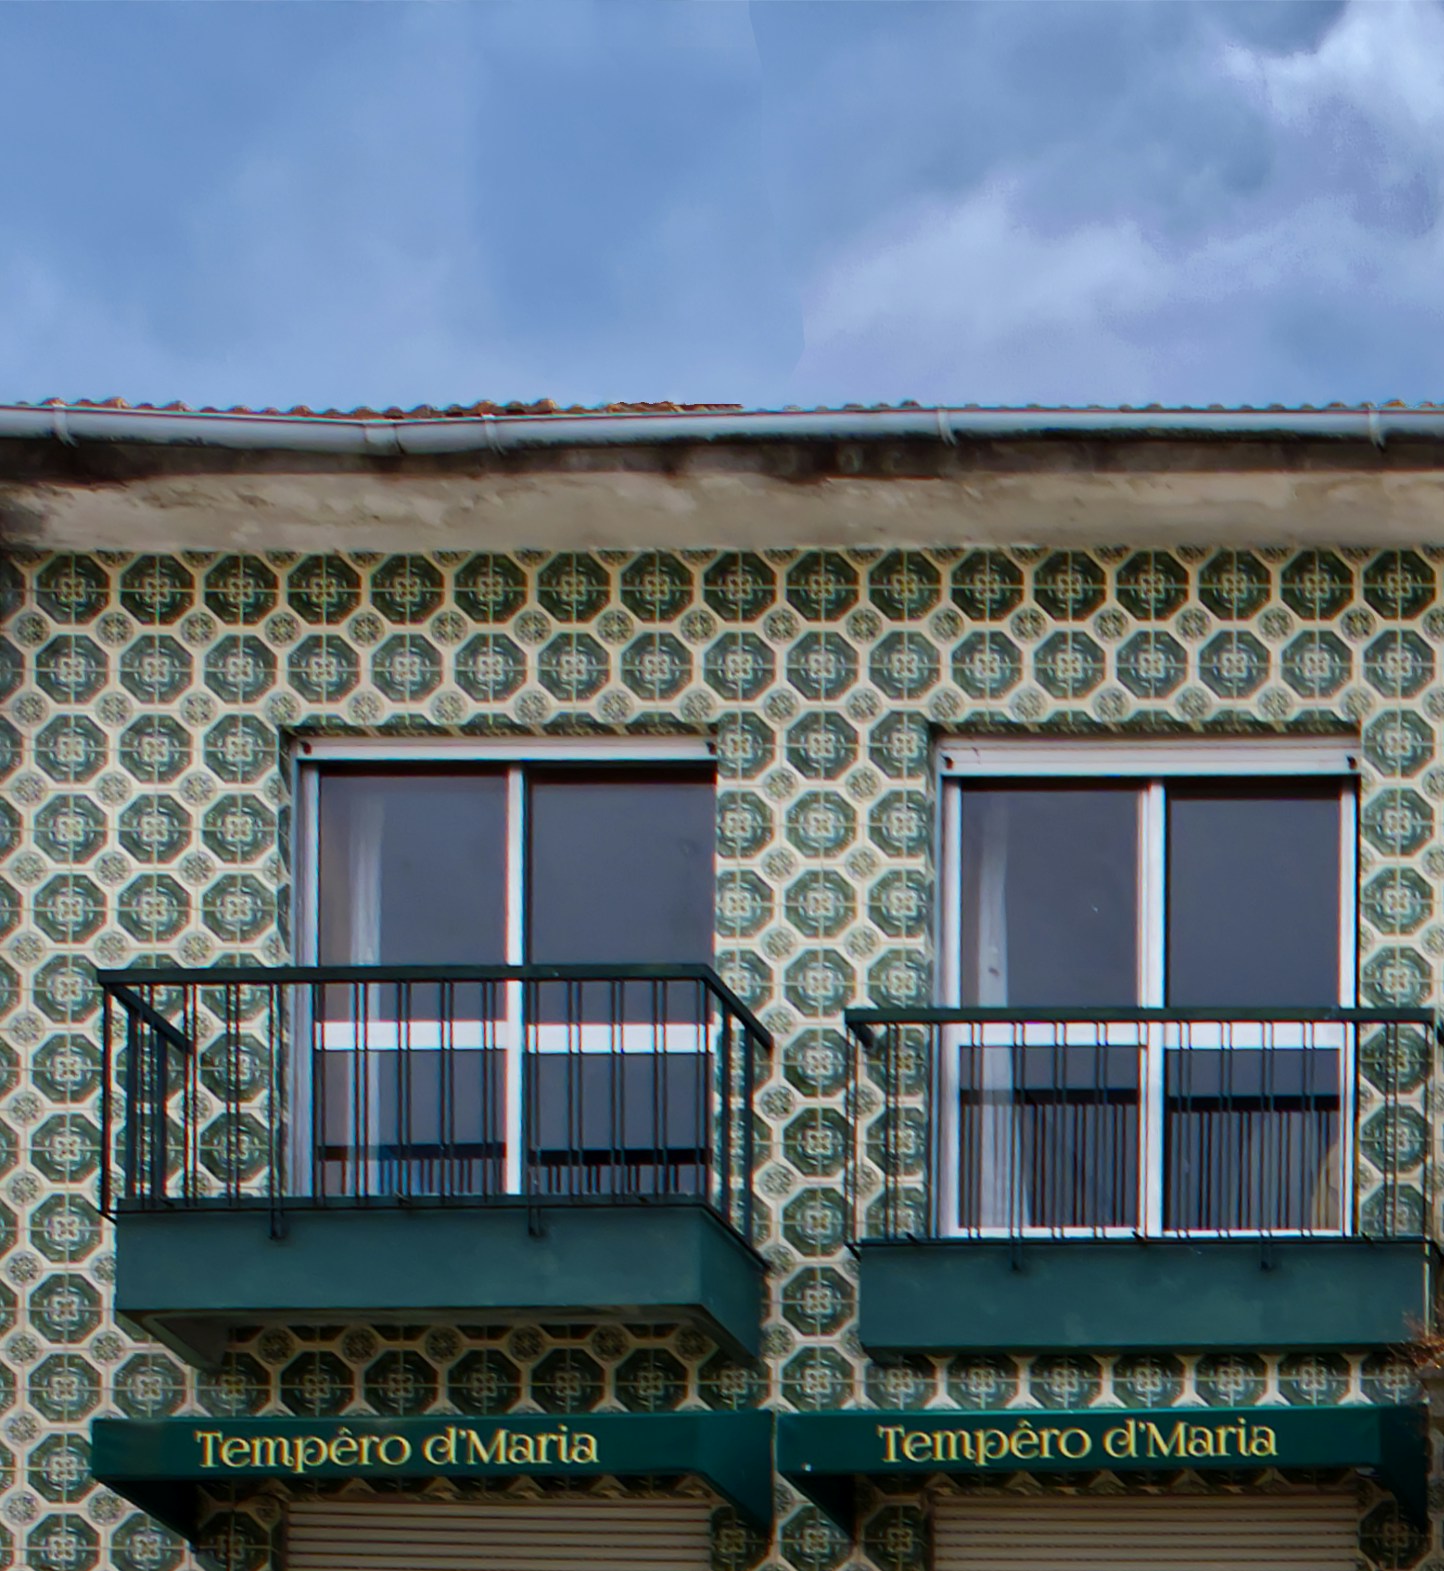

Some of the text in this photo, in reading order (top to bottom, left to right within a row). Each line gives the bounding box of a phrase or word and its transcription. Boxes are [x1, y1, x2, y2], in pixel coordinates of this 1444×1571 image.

[195, 1423, 599, 1473] Tempêro d'Maria
[878, 1416, 1277, 1466] Tempêro d'Maria
